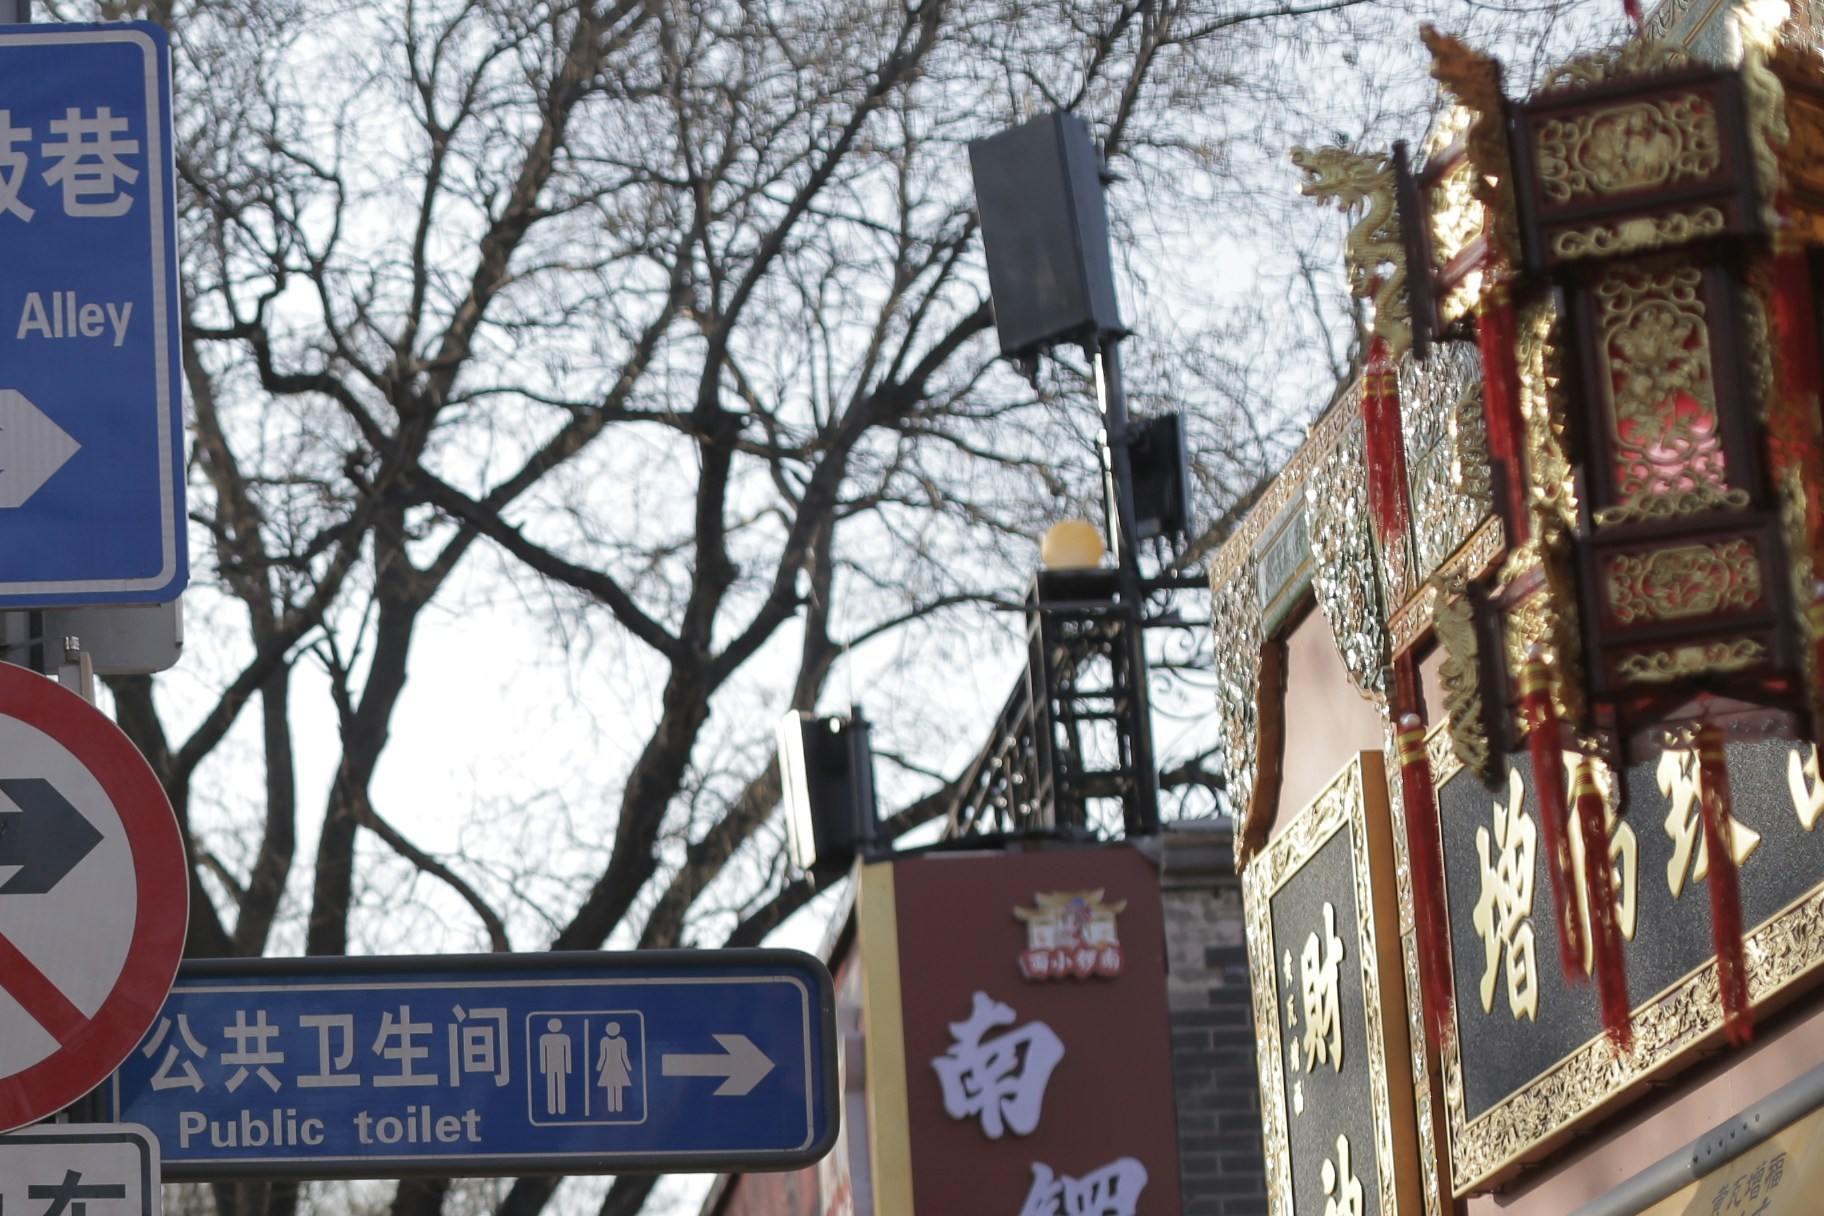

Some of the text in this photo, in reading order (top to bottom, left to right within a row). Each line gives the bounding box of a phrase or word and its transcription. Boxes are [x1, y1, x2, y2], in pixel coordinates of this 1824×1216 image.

[16, 291, 133, 347] Alley
[142, 1004, 510, 1093] 公共卫生间
[179, 1105, 482, 1148] Public toilet
